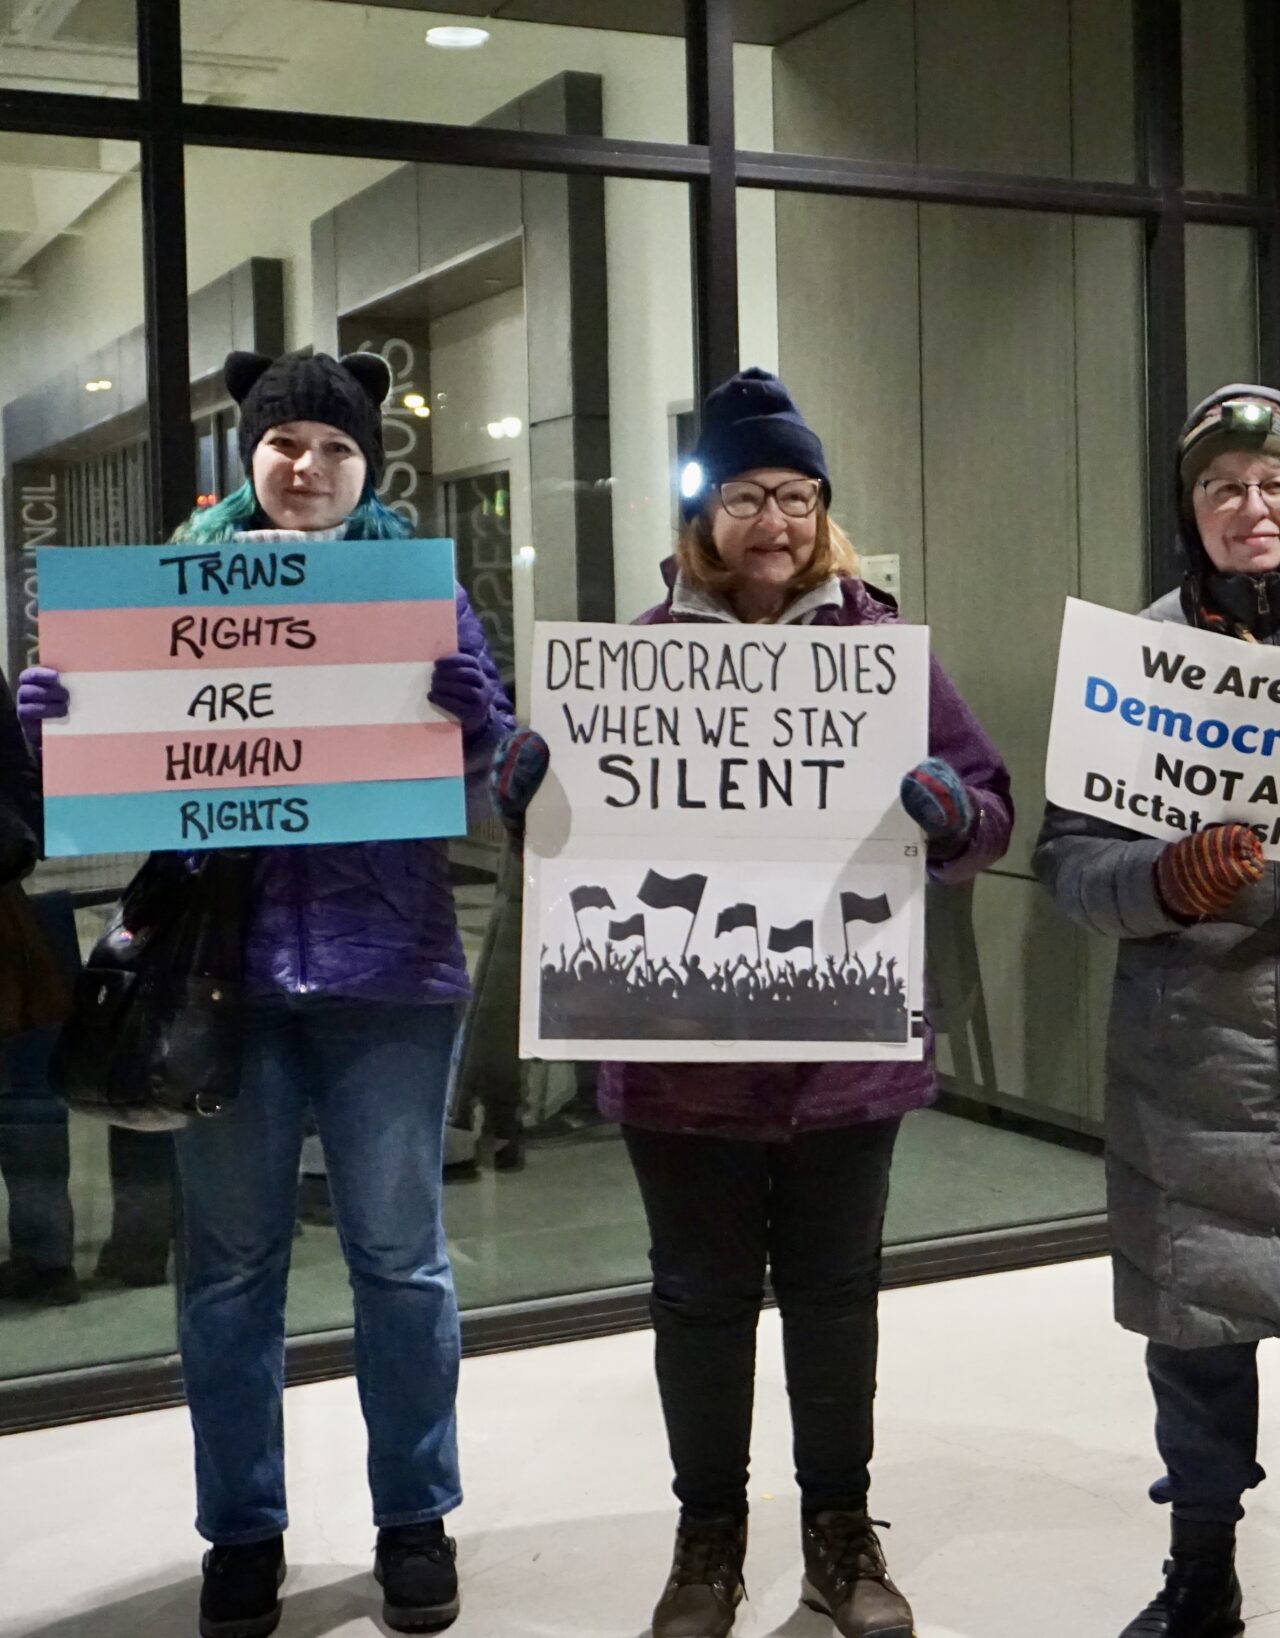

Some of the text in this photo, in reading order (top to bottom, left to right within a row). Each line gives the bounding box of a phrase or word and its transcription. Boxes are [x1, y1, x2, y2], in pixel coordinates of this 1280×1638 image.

[160, 552, 306, 595] TRANS
[169, 616, 316, 657] RIGHTS
[546, 638, 896, 695] DEMOCRACY DIES
[1141, 645, 1206, 690] We
[187, 683, 274, 721] ARE
[562, 703, 867, 748] WHEN WE STAY
[165, 738, 302, 781] HUMAN
[1154, 753, 1279, 805] NOT A
[599, 754, 845, 810] SILENT
[180, 798, 310, 840] RIGHTS
